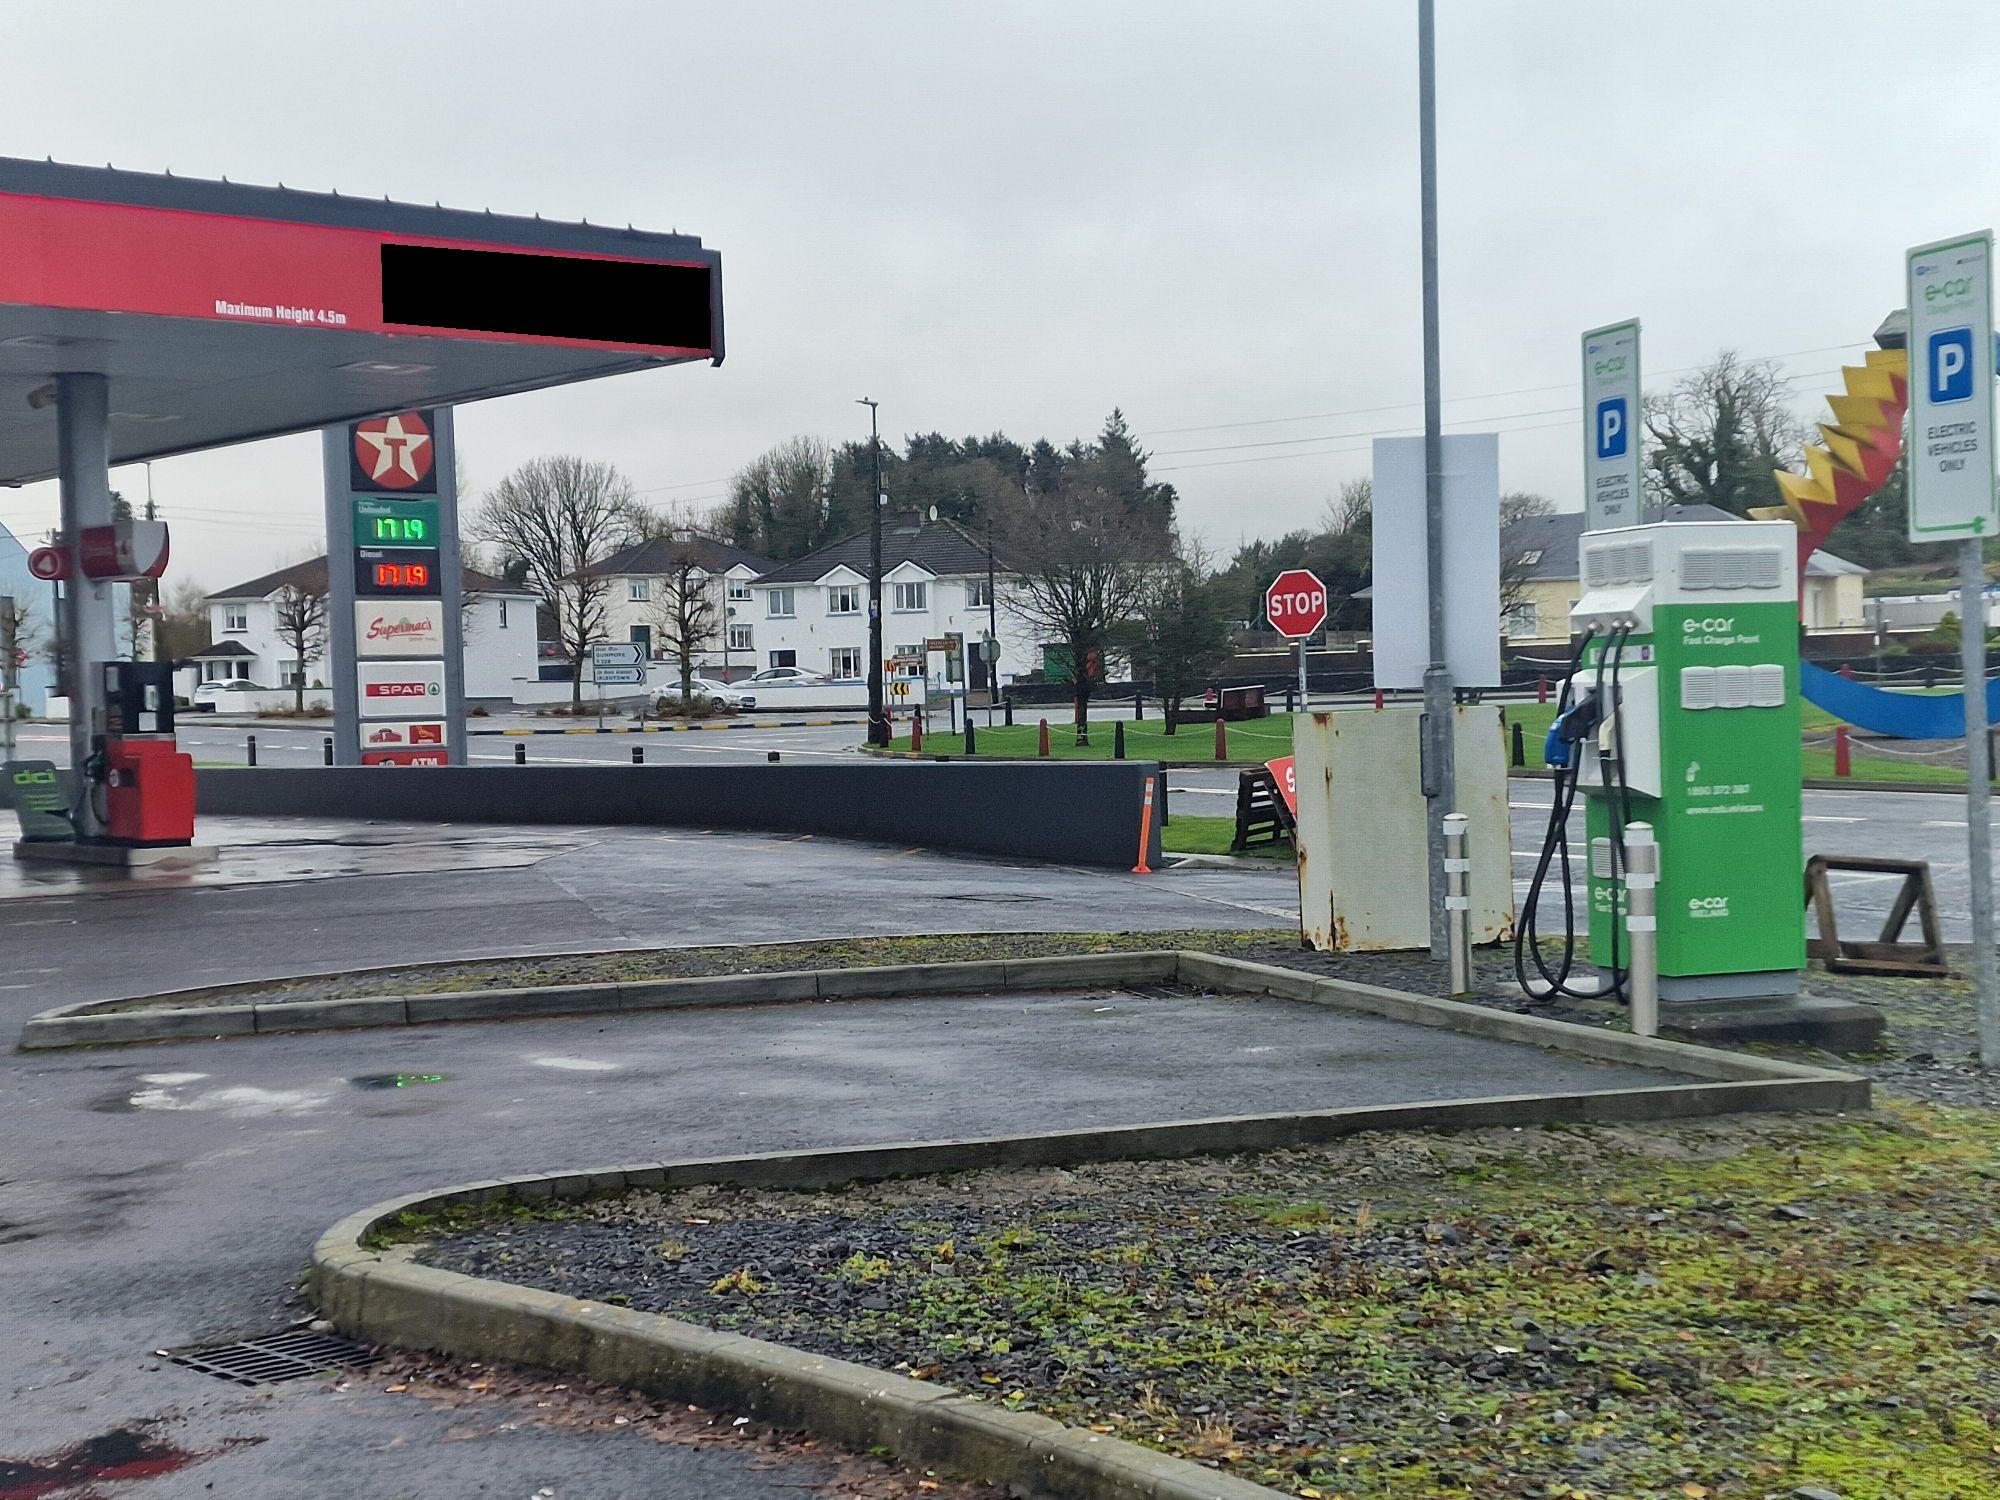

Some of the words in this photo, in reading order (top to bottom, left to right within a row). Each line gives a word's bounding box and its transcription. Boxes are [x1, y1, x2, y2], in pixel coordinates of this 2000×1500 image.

[215, 300, 273, 318] Maximum
[275, 305, 315, 324] Height
[317, 309, 347, 325] 4.5m
[1938, 343, 1965, 392] P
[1602, 409, 1622, 450] P
[1928, 421, 1977, 440] ELECTRIC
[1927, 439, 1978, 456] VEHICLES
[1270, 590, 1324, 617] STOP
[366, 616, 433, 640] Supermac's
[1682, 617, 1736, 633] e-car
[378, 684, 425, 695] SPAR
[410, 757, 439, 766] ATM
[1688, 896, 1729, 910] e-car
